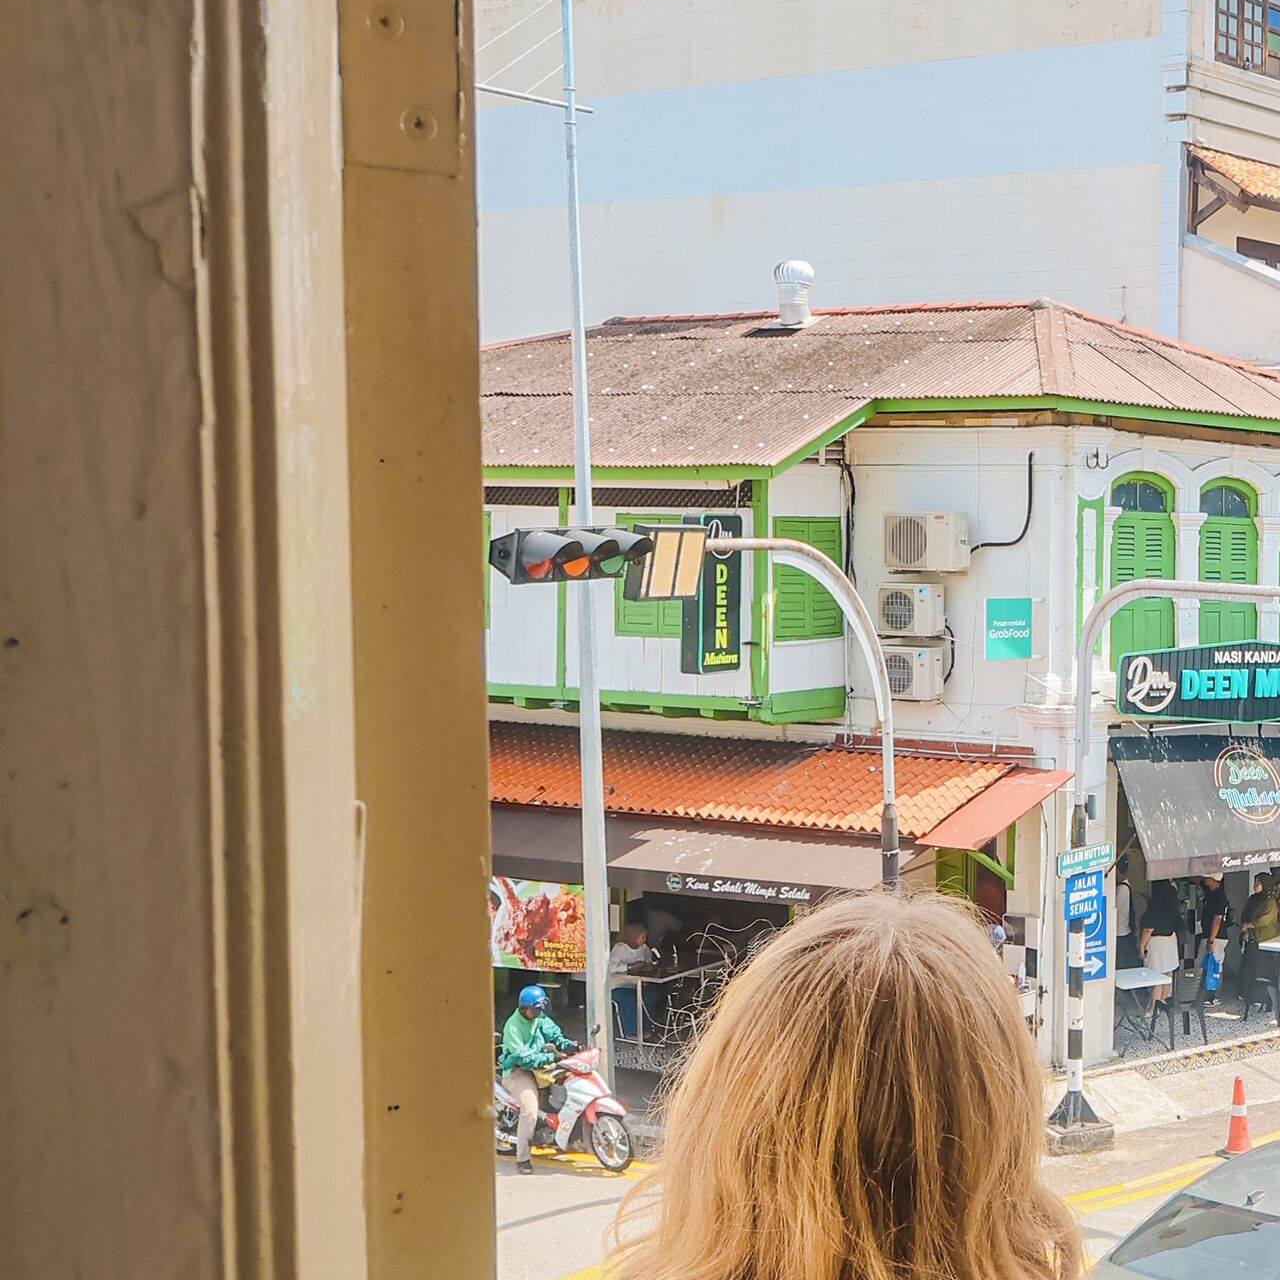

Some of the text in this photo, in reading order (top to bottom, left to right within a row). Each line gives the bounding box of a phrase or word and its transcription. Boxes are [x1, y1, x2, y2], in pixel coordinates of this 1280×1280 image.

[715, 564, 729, 649] DEEN
[990, 628, 1030, 639] GrabFood
[703, 651, 739, 666] Mutiara
[1214, 651, 1242, 664] NASI
[1181, 669, 1249, 700] DEEN
[1226, 756, 1268, 785] Deen
[1062, 849, 1084, 867] JALAN
[1084, 843, 1110, 860] HUTTON
[1221, 856, 1242, 868] Kena
[685, 877, 811, 901] Kena Sekali Mimpi Selalu
[1073, 876, 1097, 891] JALAN
[1069, 900, 1098, 916] SEHALA
